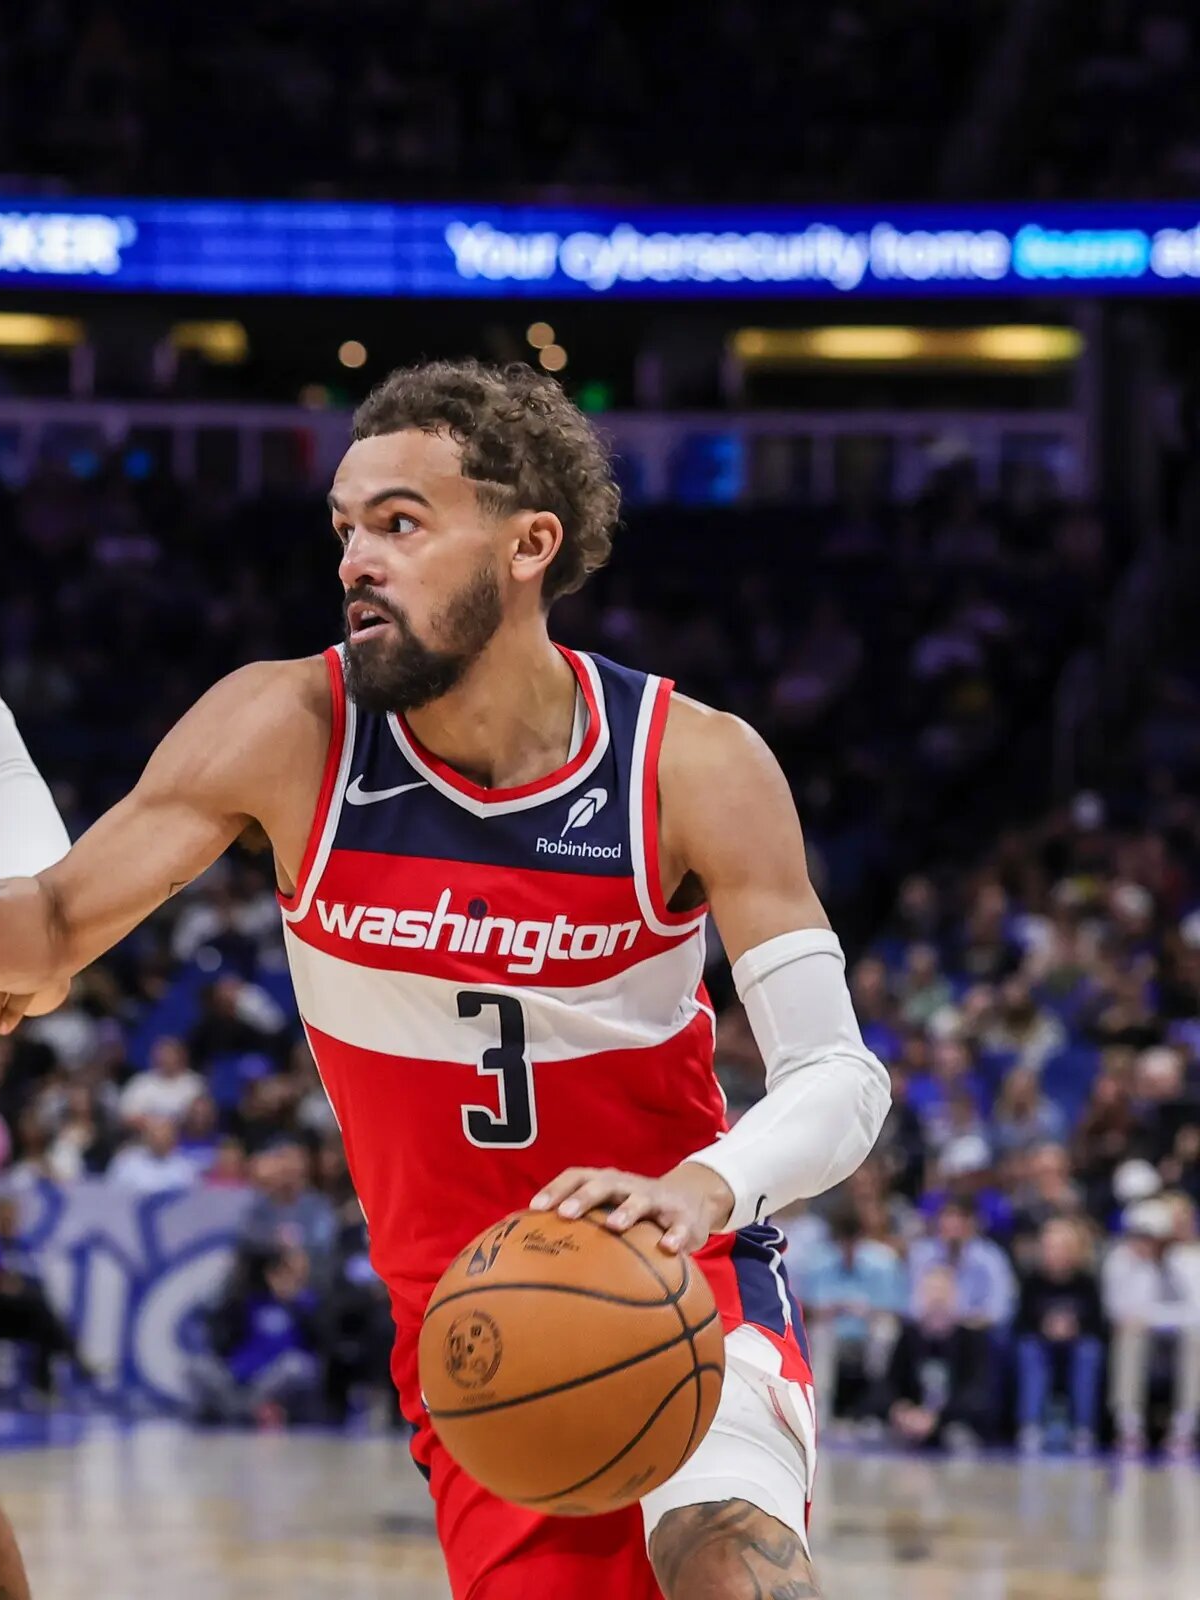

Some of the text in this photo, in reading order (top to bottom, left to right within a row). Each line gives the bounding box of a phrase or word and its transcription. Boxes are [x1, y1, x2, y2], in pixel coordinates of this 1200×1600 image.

[445, 221, 558, 280] Your
[560, 222, 869, 291] cybersecurity
[536, 837, 622, 859] Robinhood
[315, 887, 643, 975] washington
[456, 988, 538, 1149] 3
